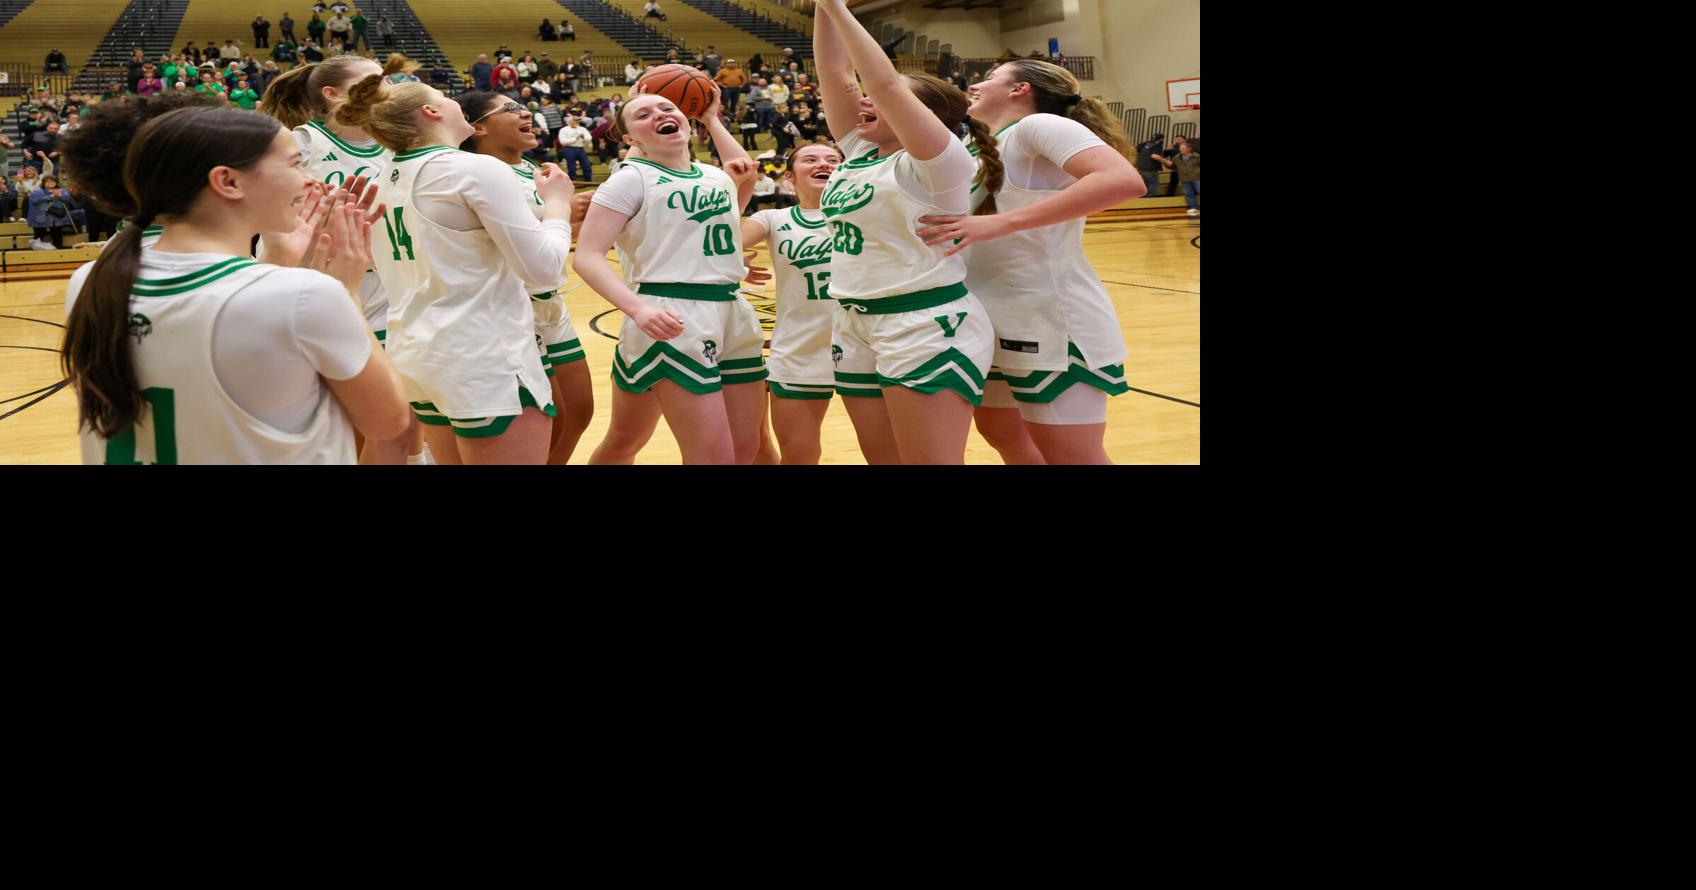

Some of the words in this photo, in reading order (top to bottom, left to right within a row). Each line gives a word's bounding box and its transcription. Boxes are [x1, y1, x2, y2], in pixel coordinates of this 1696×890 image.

[383, 206, 415, 261] 14
[703, 223, 736, 257] 10
[778, 235, 833, 261] Valp
[832, 220, 864, 256] 20
[804, 271, 832, 300] 12
[934, 311, 968, 337] V
